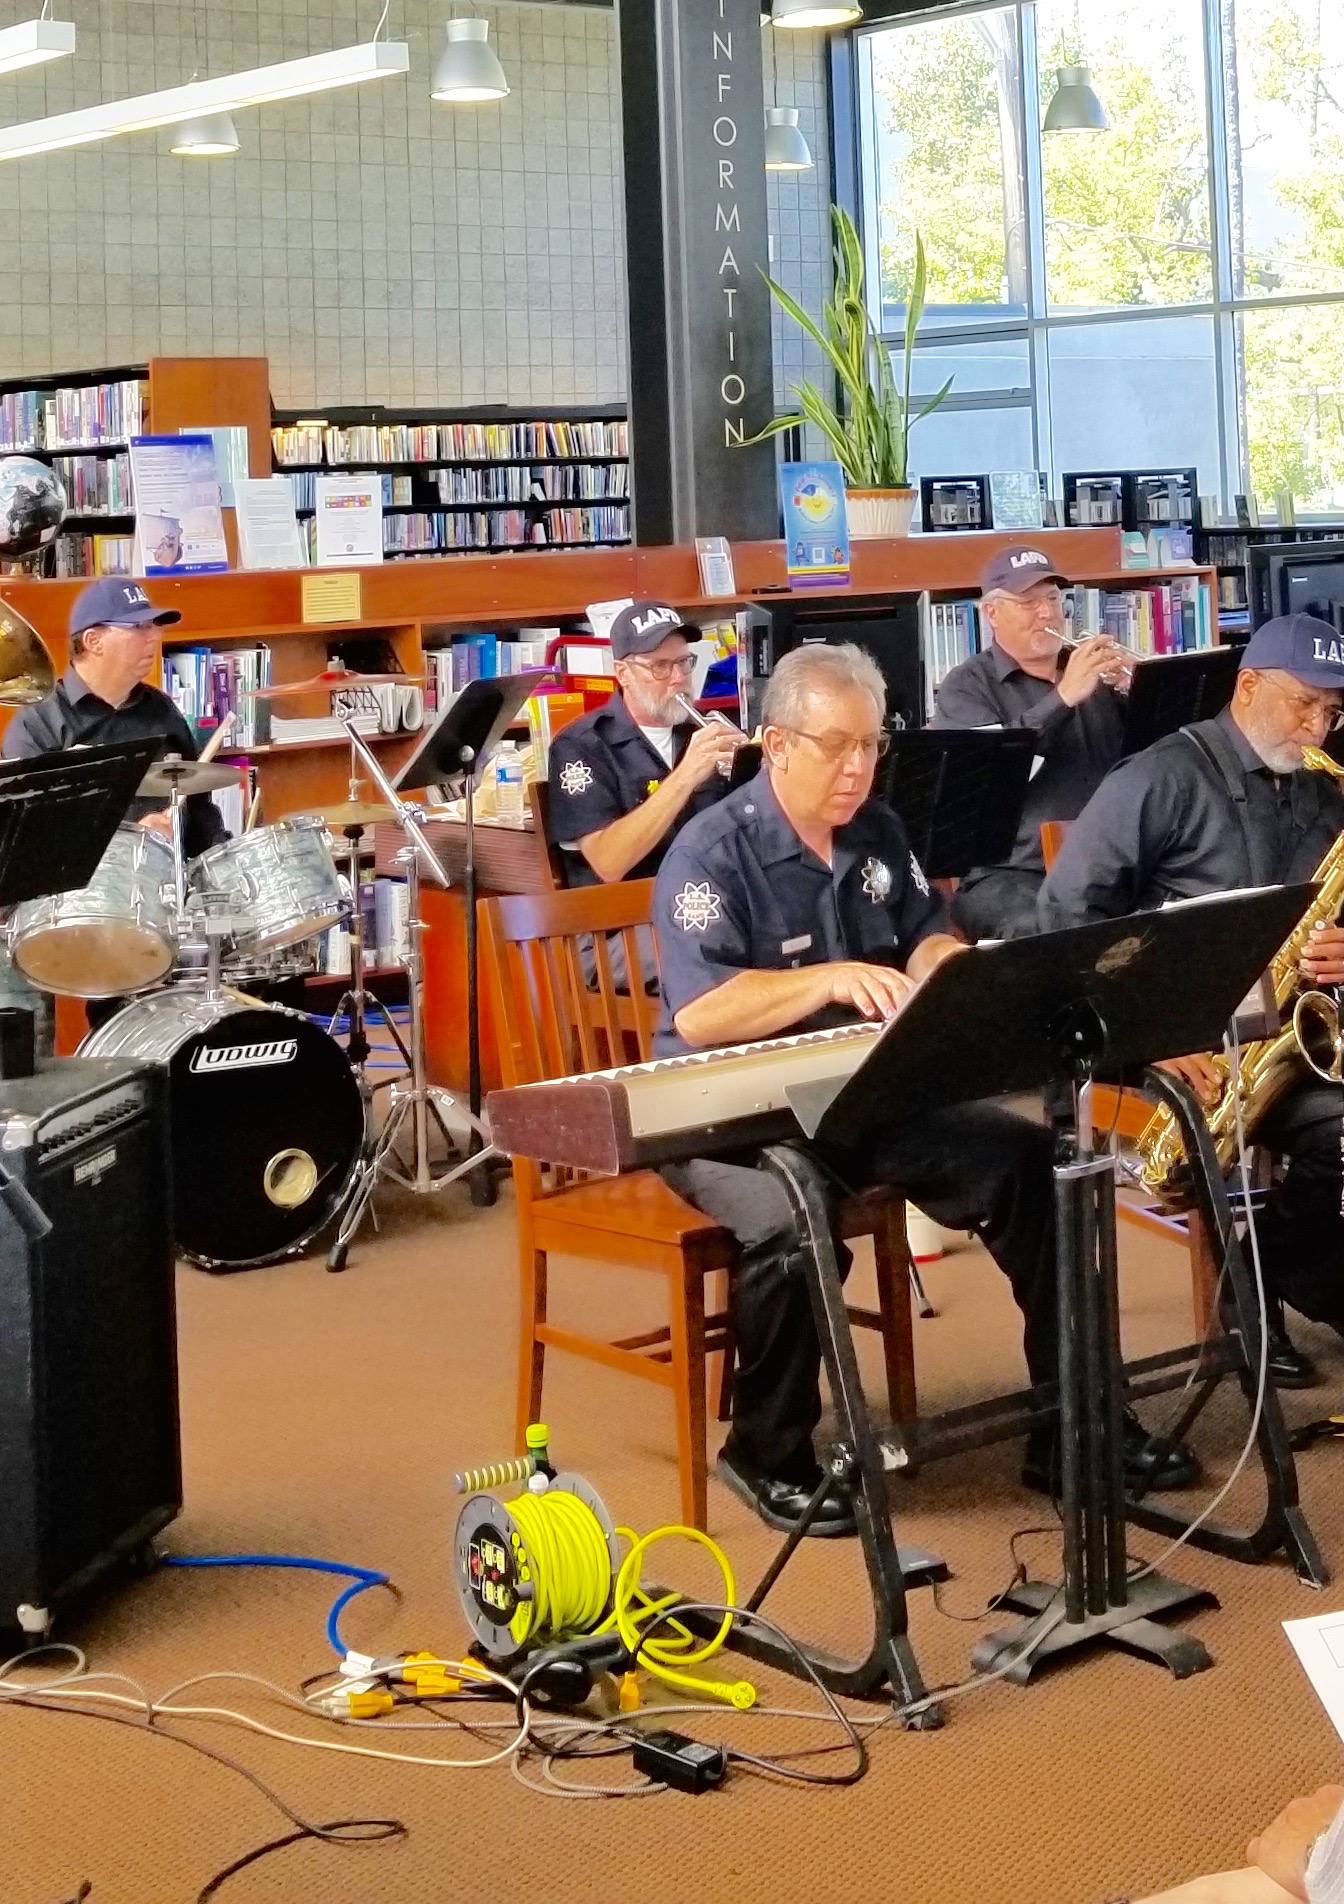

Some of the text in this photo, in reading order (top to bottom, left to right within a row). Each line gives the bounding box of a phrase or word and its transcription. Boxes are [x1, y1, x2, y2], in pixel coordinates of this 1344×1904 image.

[712, 0, 746, 448] INFORMATION
[1010, 551, 1049, 568] LAPD
[123, 587, 150, 604] LA
[631, 607, 681, 634] LAPD
[683, 901, 711, 911] POLICE
